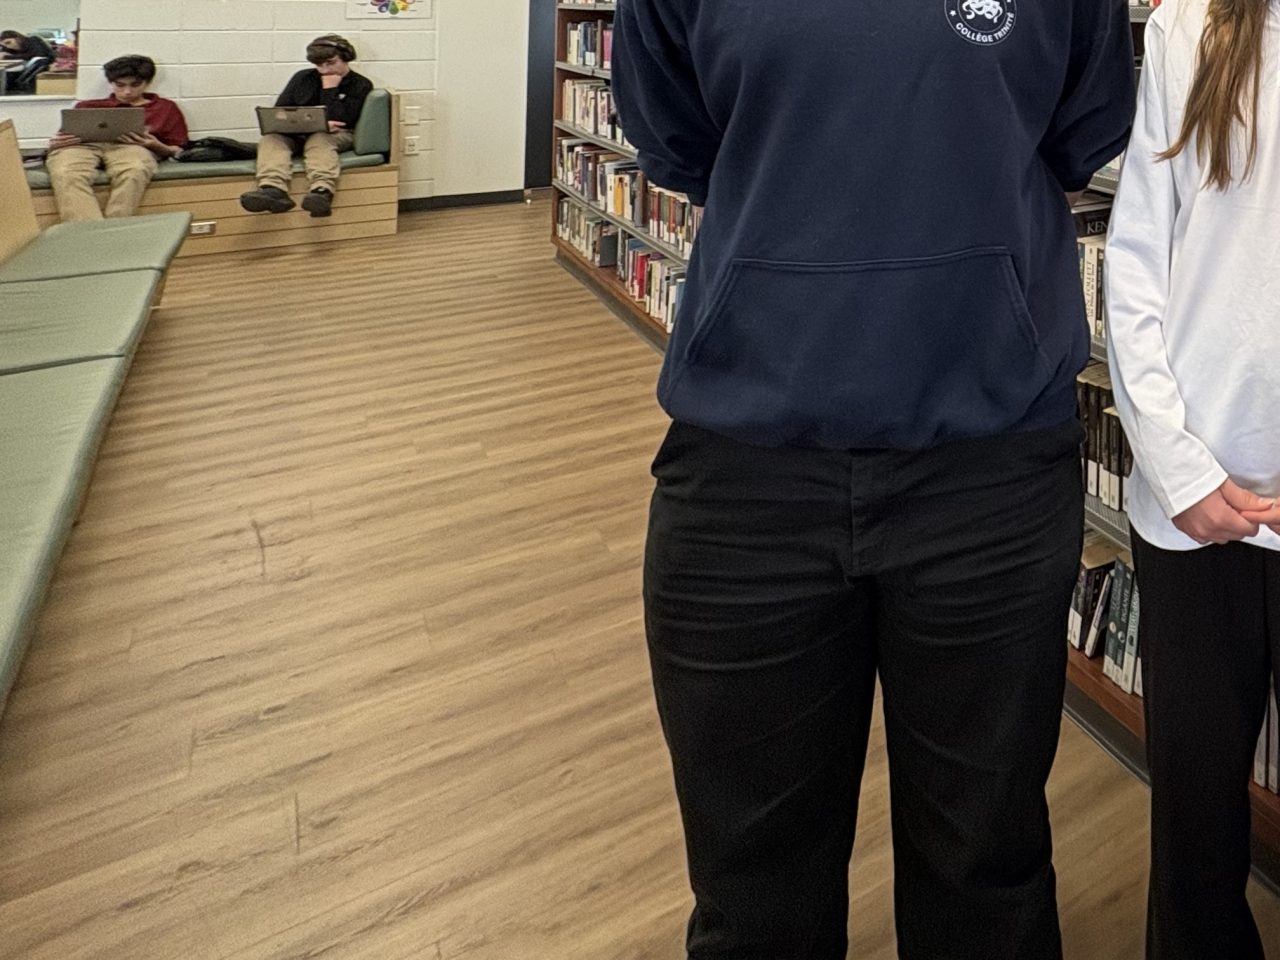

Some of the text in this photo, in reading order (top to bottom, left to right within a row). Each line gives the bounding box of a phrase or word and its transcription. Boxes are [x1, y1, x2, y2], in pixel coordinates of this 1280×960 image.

[955, 12, 1015, 43] COLLÈGE TRINITÉ
[1087, 220, 1109, 235] KEN
